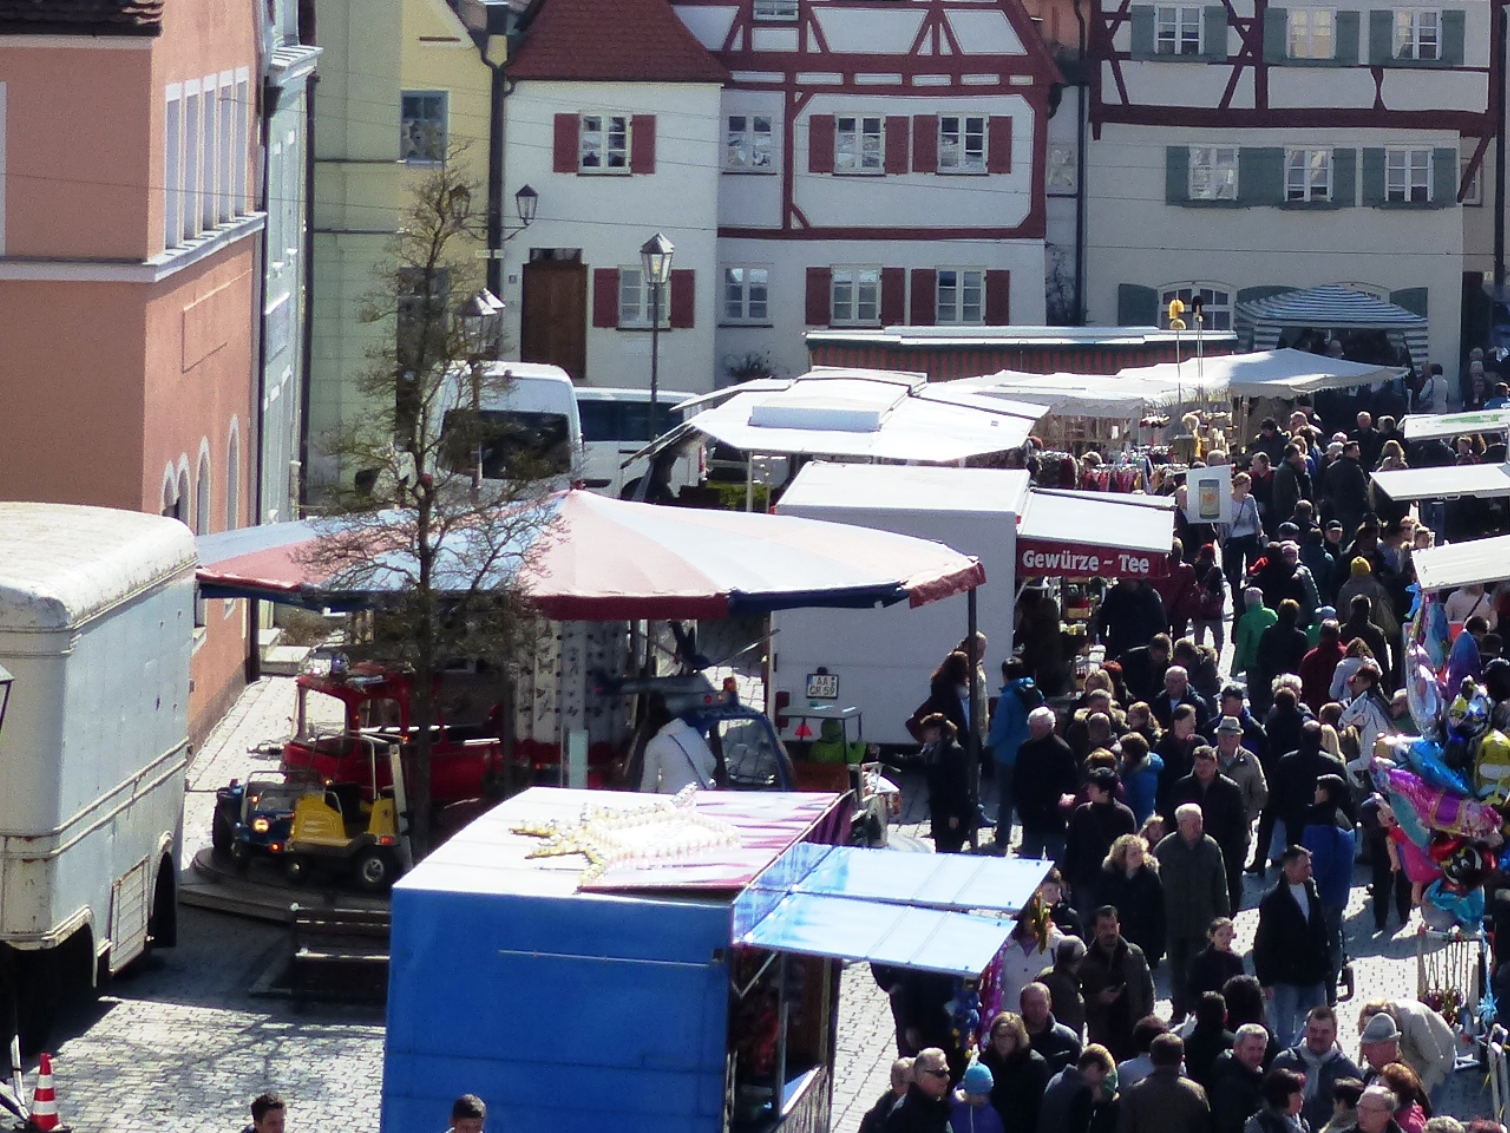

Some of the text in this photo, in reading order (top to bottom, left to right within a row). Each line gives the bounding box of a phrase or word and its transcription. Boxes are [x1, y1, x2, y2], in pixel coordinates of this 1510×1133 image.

[1022, 549, 1099, 572] Gewürze
[1118, 554, 1149, 573] Tee
[816, 676, 828, 686] AA
